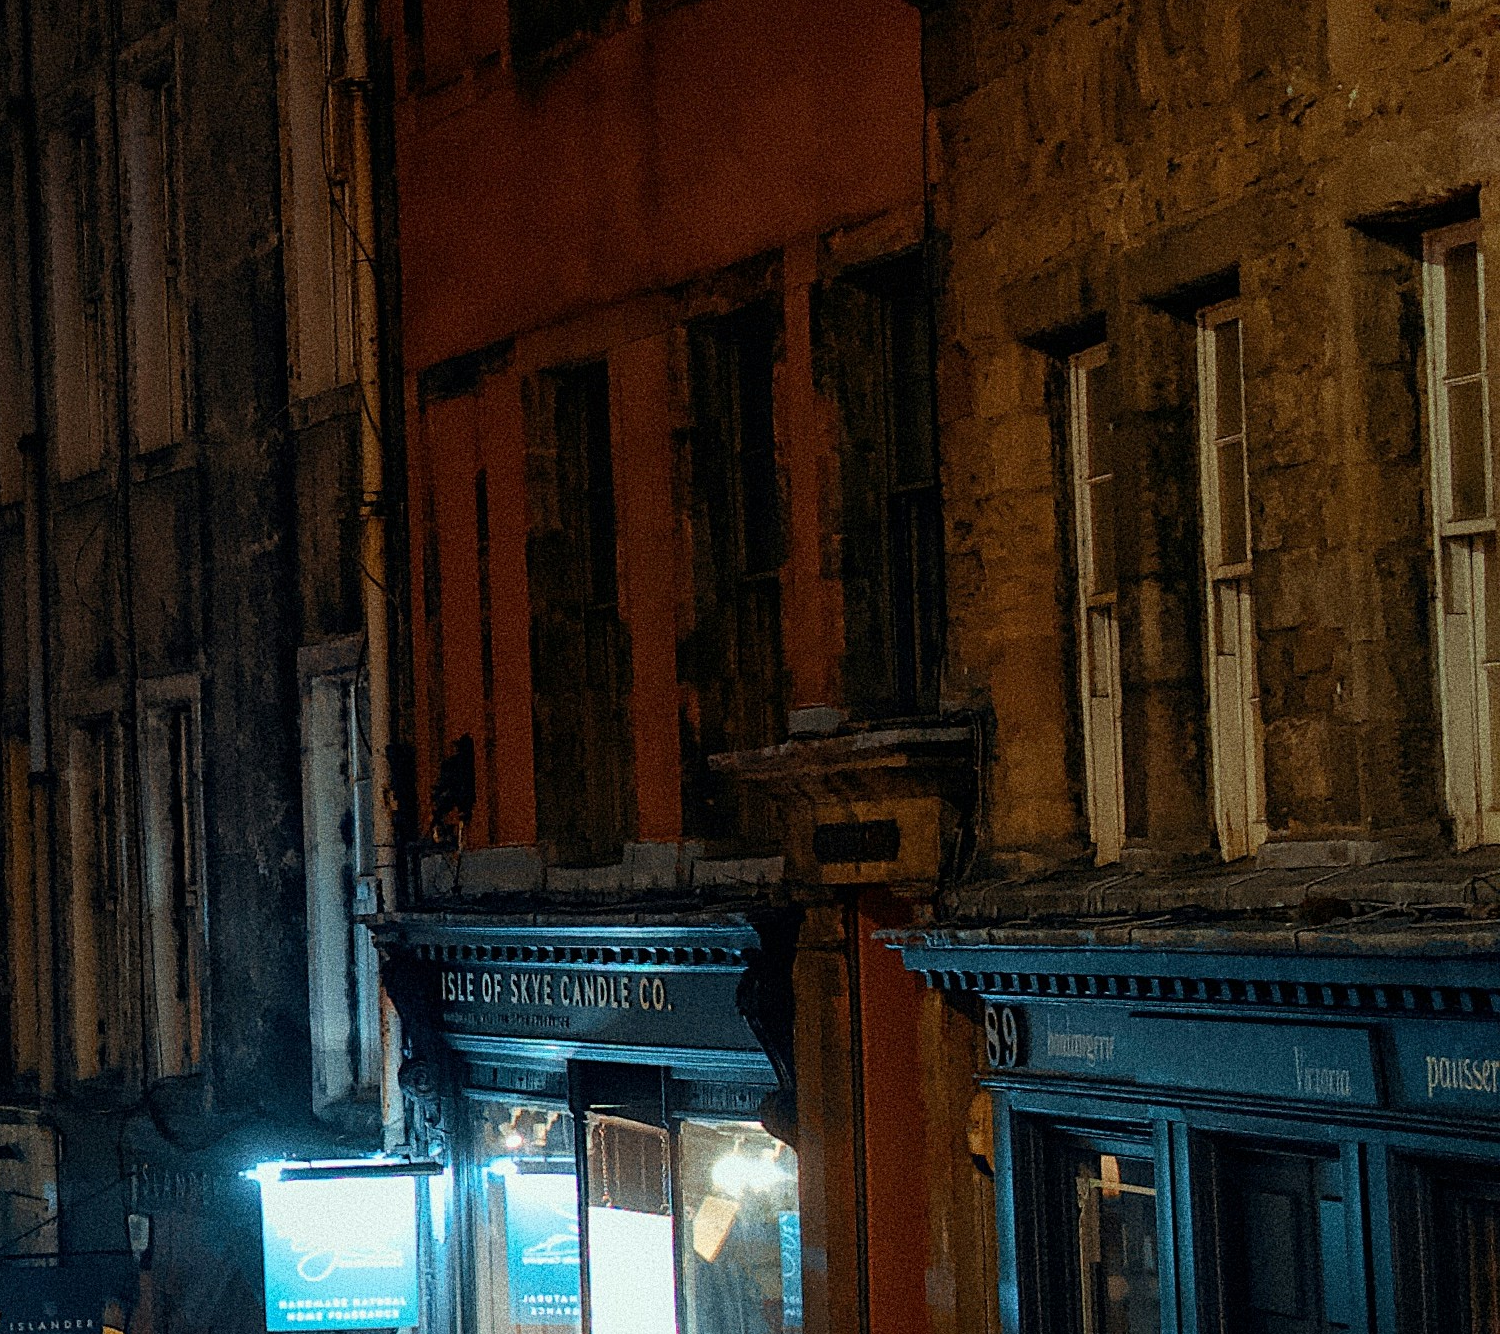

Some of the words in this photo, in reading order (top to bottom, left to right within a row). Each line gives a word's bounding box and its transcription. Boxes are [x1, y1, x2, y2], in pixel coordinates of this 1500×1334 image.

[440, 971, 475, 1003] ISLE
[480, 972, 502, 1004] OF
[510, 973, 553, 1006] SKYE
[560, 975, 630, 1010] CANDLE
[638, 978, 674, 1012] CO.
[984, 1006, 1018, 1069] 89
[9, 1319, 94, 1332] ISLANDER
